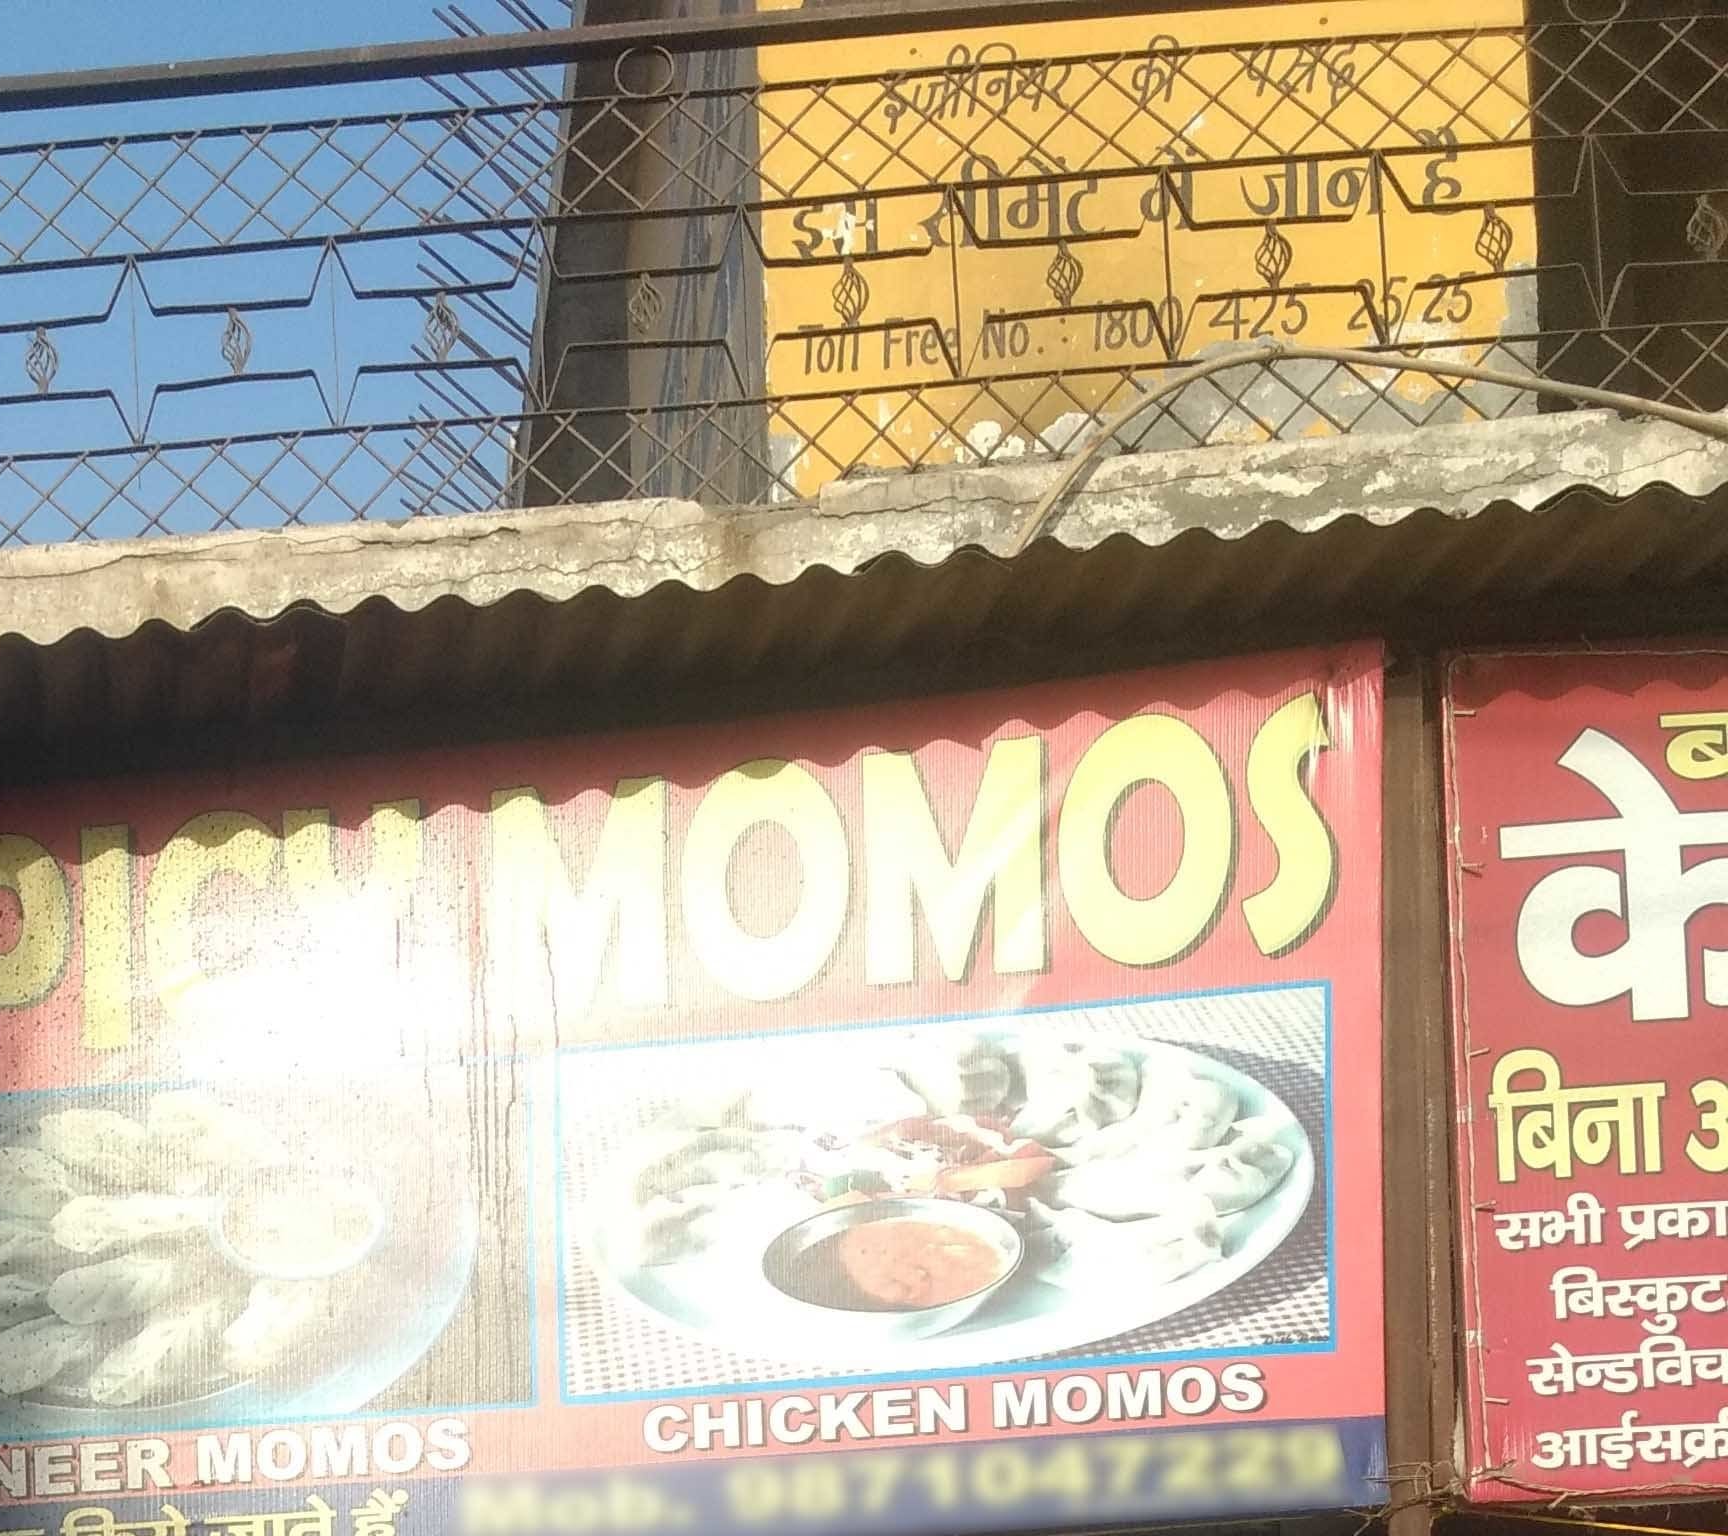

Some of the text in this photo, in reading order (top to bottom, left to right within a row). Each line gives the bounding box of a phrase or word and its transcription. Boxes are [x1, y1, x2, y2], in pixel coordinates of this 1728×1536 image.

[883, 317, 959, 369] Free
[1208, 282, 1309, 340] 425
[486, 692, 1342, 1015] MOMOS
[1487, 1047, 1666, 1184] बिना
[1493, 1192, 1607, 1251] सभी
[195, 1418, 474, 1486] MOMOS
[640, 1362, 1270, 1456] CHICKEN MOMOS
